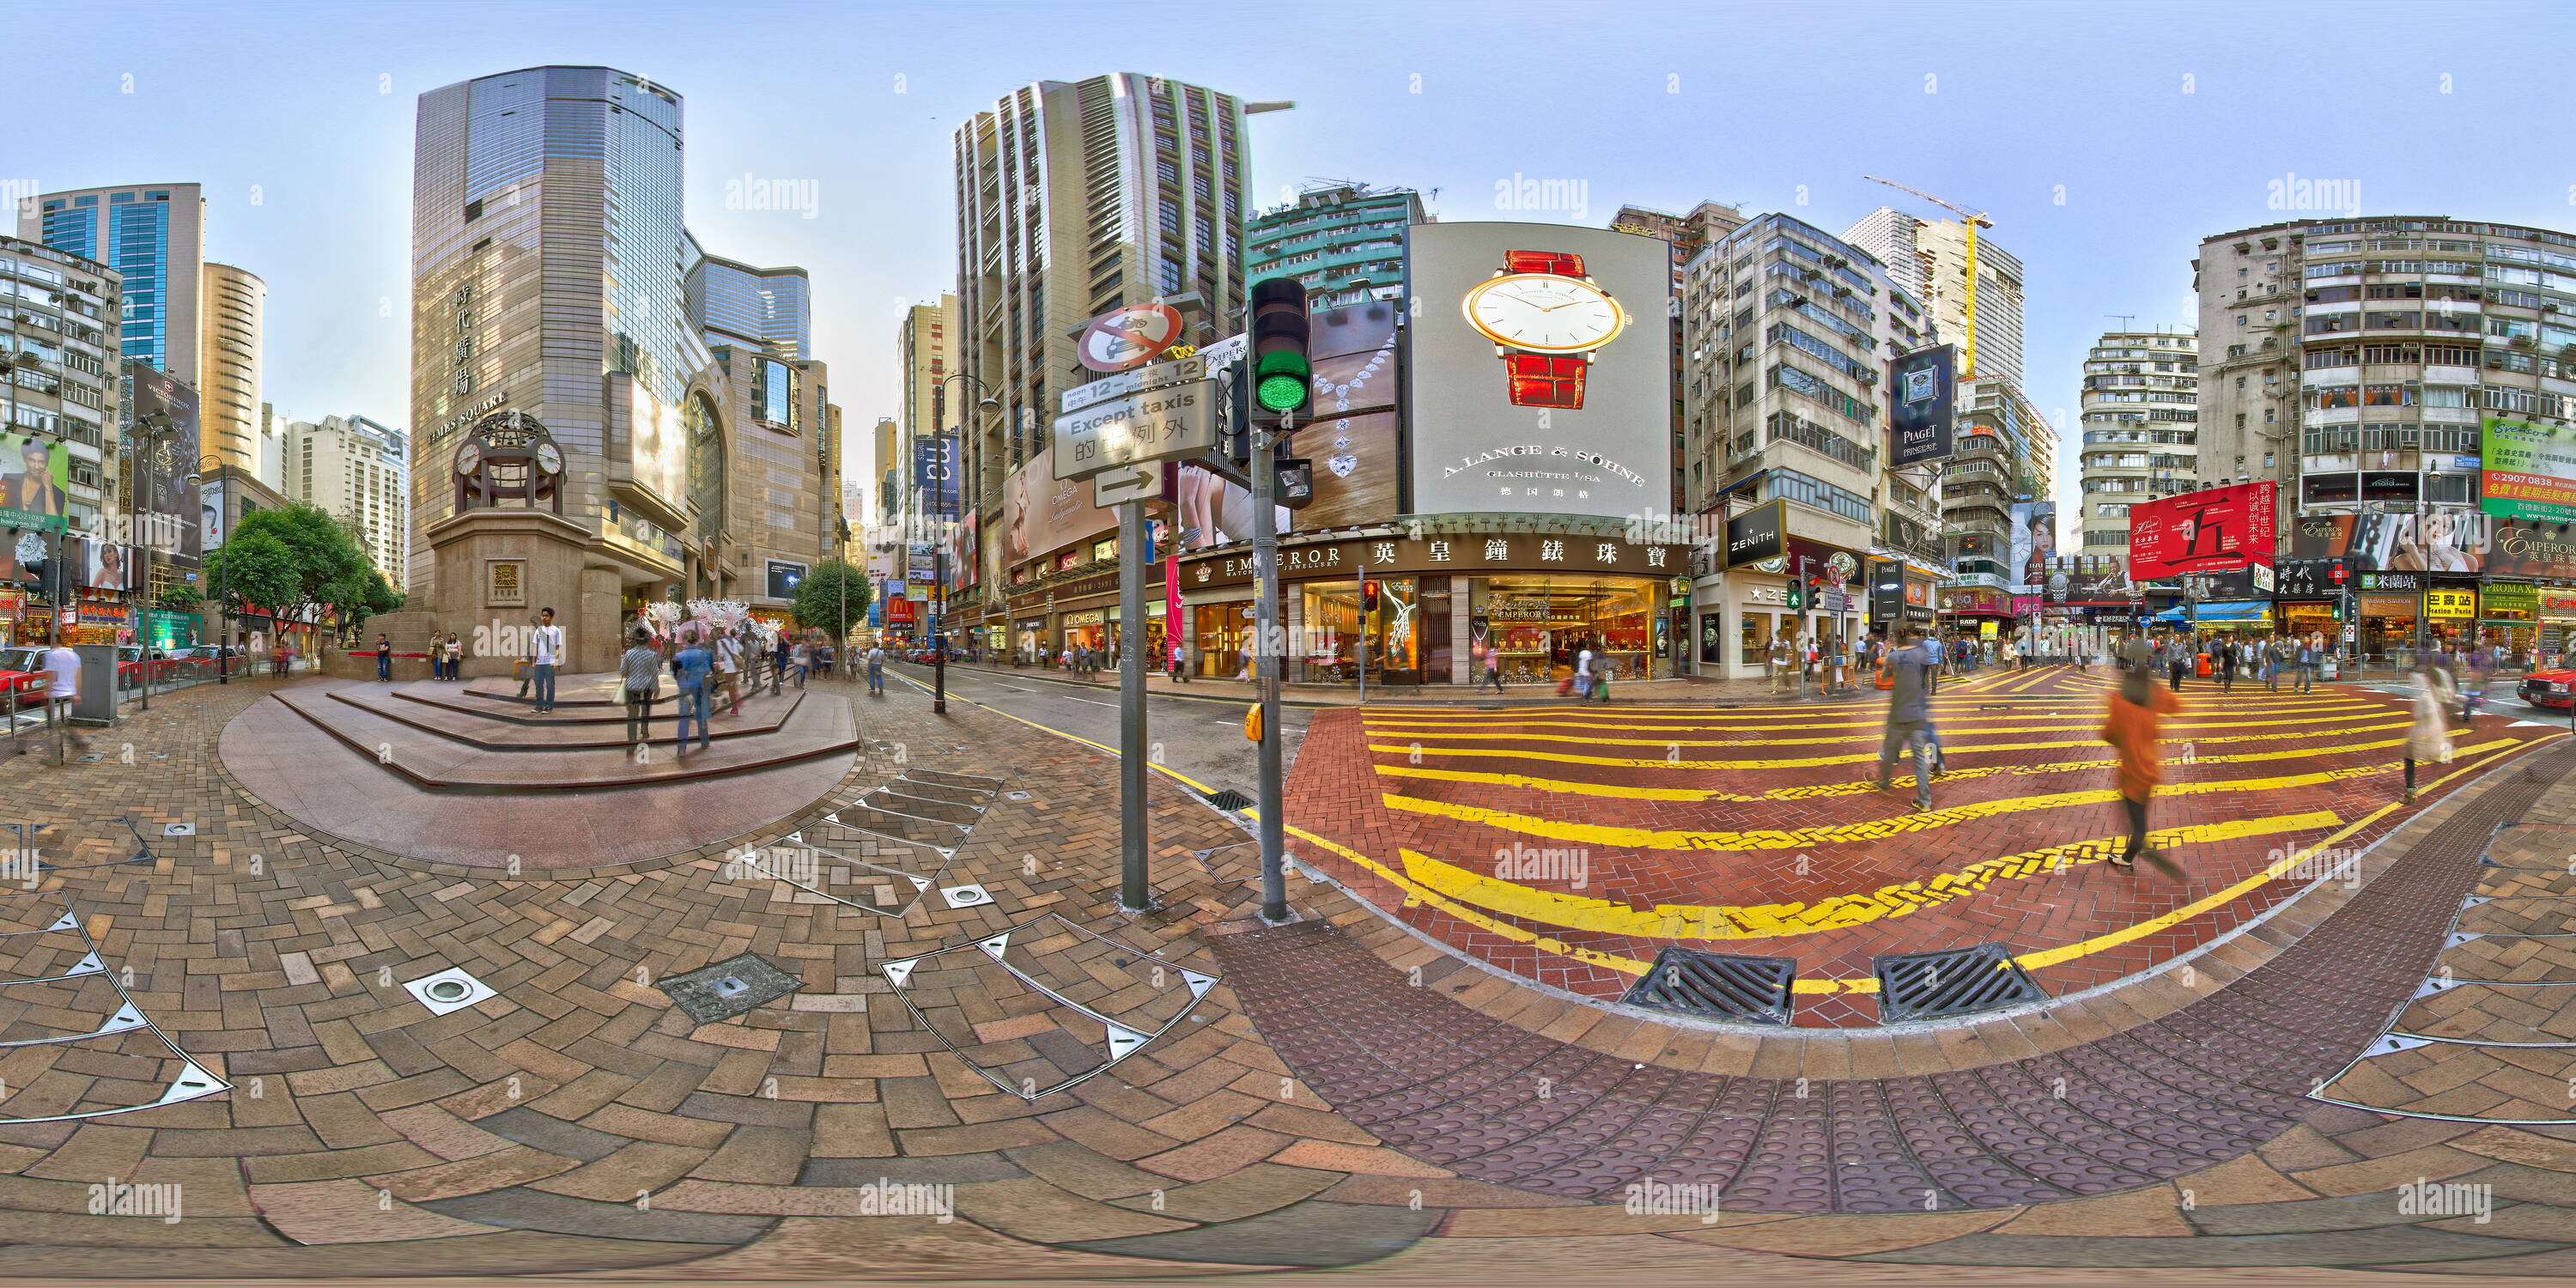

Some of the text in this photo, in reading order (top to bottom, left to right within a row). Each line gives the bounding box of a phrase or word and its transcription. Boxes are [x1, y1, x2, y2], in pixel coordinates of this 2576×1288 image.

[1135, 368, 1159, 381] 午夜
[1174, 361, 1199, 377] 12
[1126, 375, 1169, 392] midnight
[147, 383, 191, 410] VICTORINOX
[1067, 388, 1086, 399] noon
[1067, 396, 1086, 408] 中午
[426, 391, 508, 445] TIMES SQUARE
[1071, 393, 1194, 435] Except taxis
[1075, 416, 1189, 462] 的士例外
[1904, 424, 1938, 444] PIAGET
[1486, 470, 1570, 480] GLASHÜTTE
[1551, 446, 1568, 458] &
[1575, 451, 1646, 489] SÖHNE
[2501, 473, 2526, 483] 2907
[2528, 477, 2553, 487] 0838
[1052, 485, 1078, 505] OMEGA
[1048, 501, 1084, 524] Ladymatic
[2249, 490, 2259, 544] 以诚创未来
[1731, 530, 1774, 552] ZENITH
[1226, 548, 1340, 573] EMEROR
[1374, 539, 1667, 568] 英皇鐘錶珠寶
[1285, 561, 1340, 571] JEWELLERY
[1881, 564, 1897, 574] PIAGET
[2280, 565, 2312, 581] 時代
[2377, 574, 2417, 589] 米蘭站
[1074, 613, 1100, 624] OMEGA
[1498, 611, 1542, 619] EMPEROR
